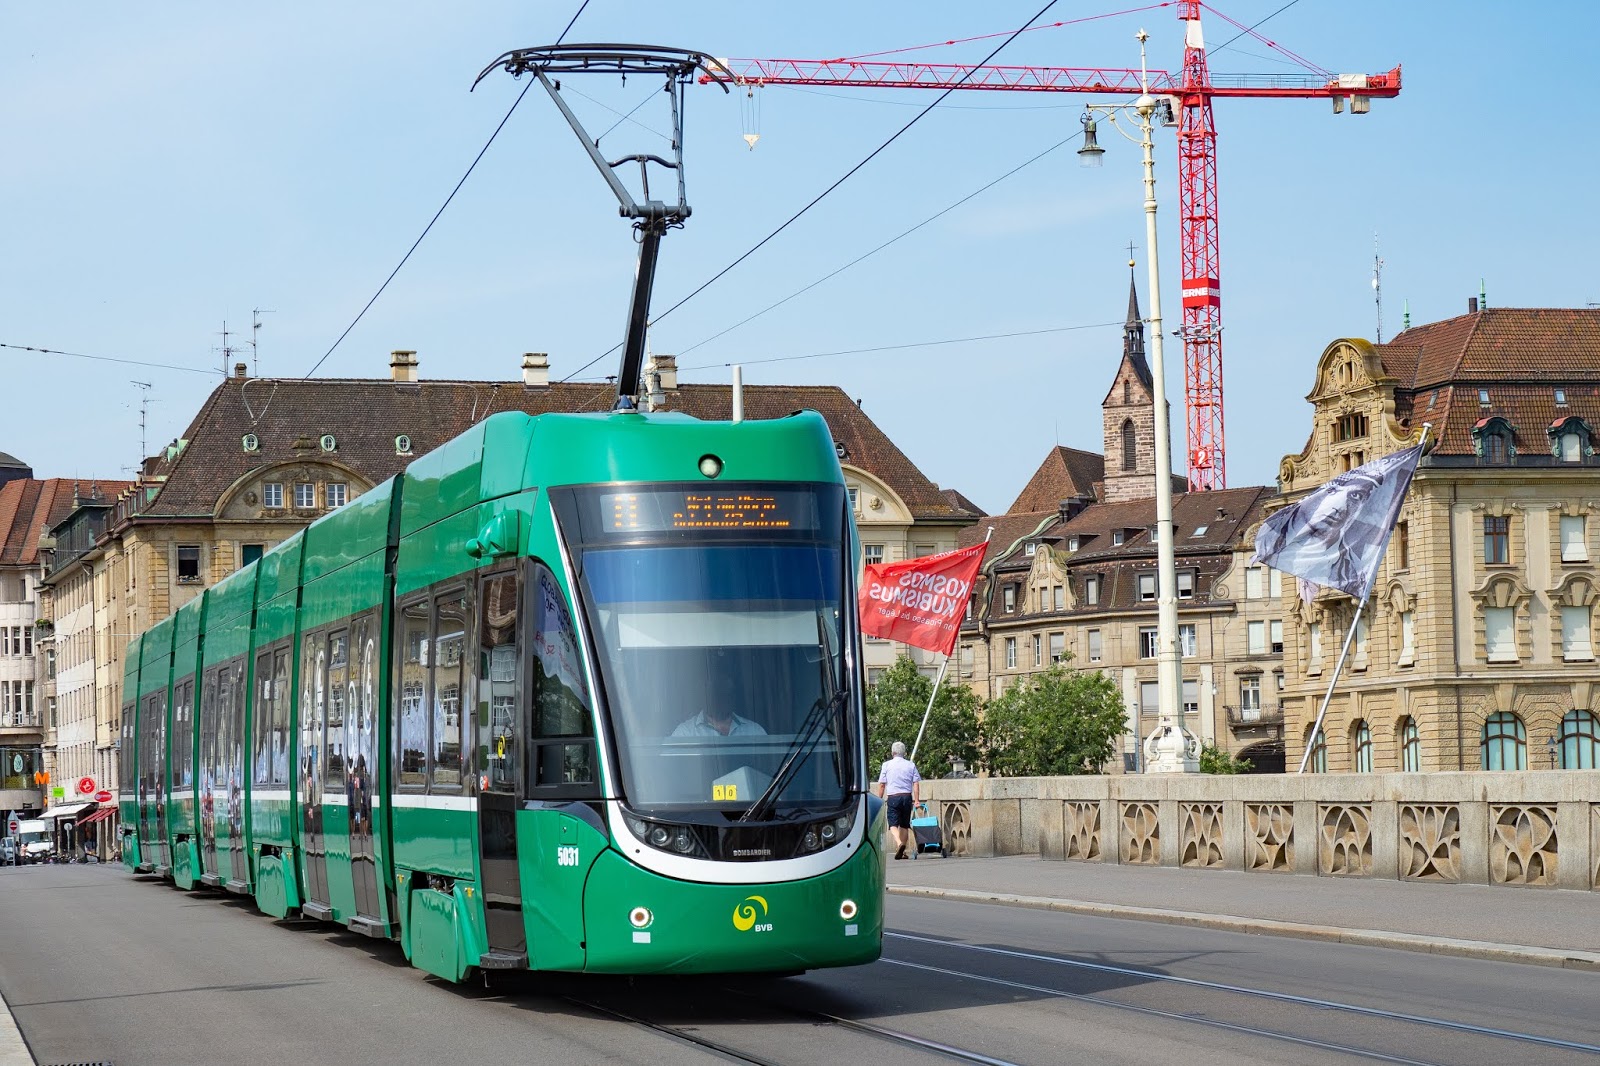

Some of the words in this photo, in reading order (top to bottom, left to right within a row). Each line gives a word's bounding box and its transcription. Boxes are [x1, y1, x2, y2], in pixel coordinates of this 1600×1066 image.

[1183, 287, 1208, 298] ERNE
[35, 771, 51, 784] M
[557, 846, 579, 866] 5031
[733, 849, 771, 857] BOMBARDIER
[755, 923, 773, 932] BVB
